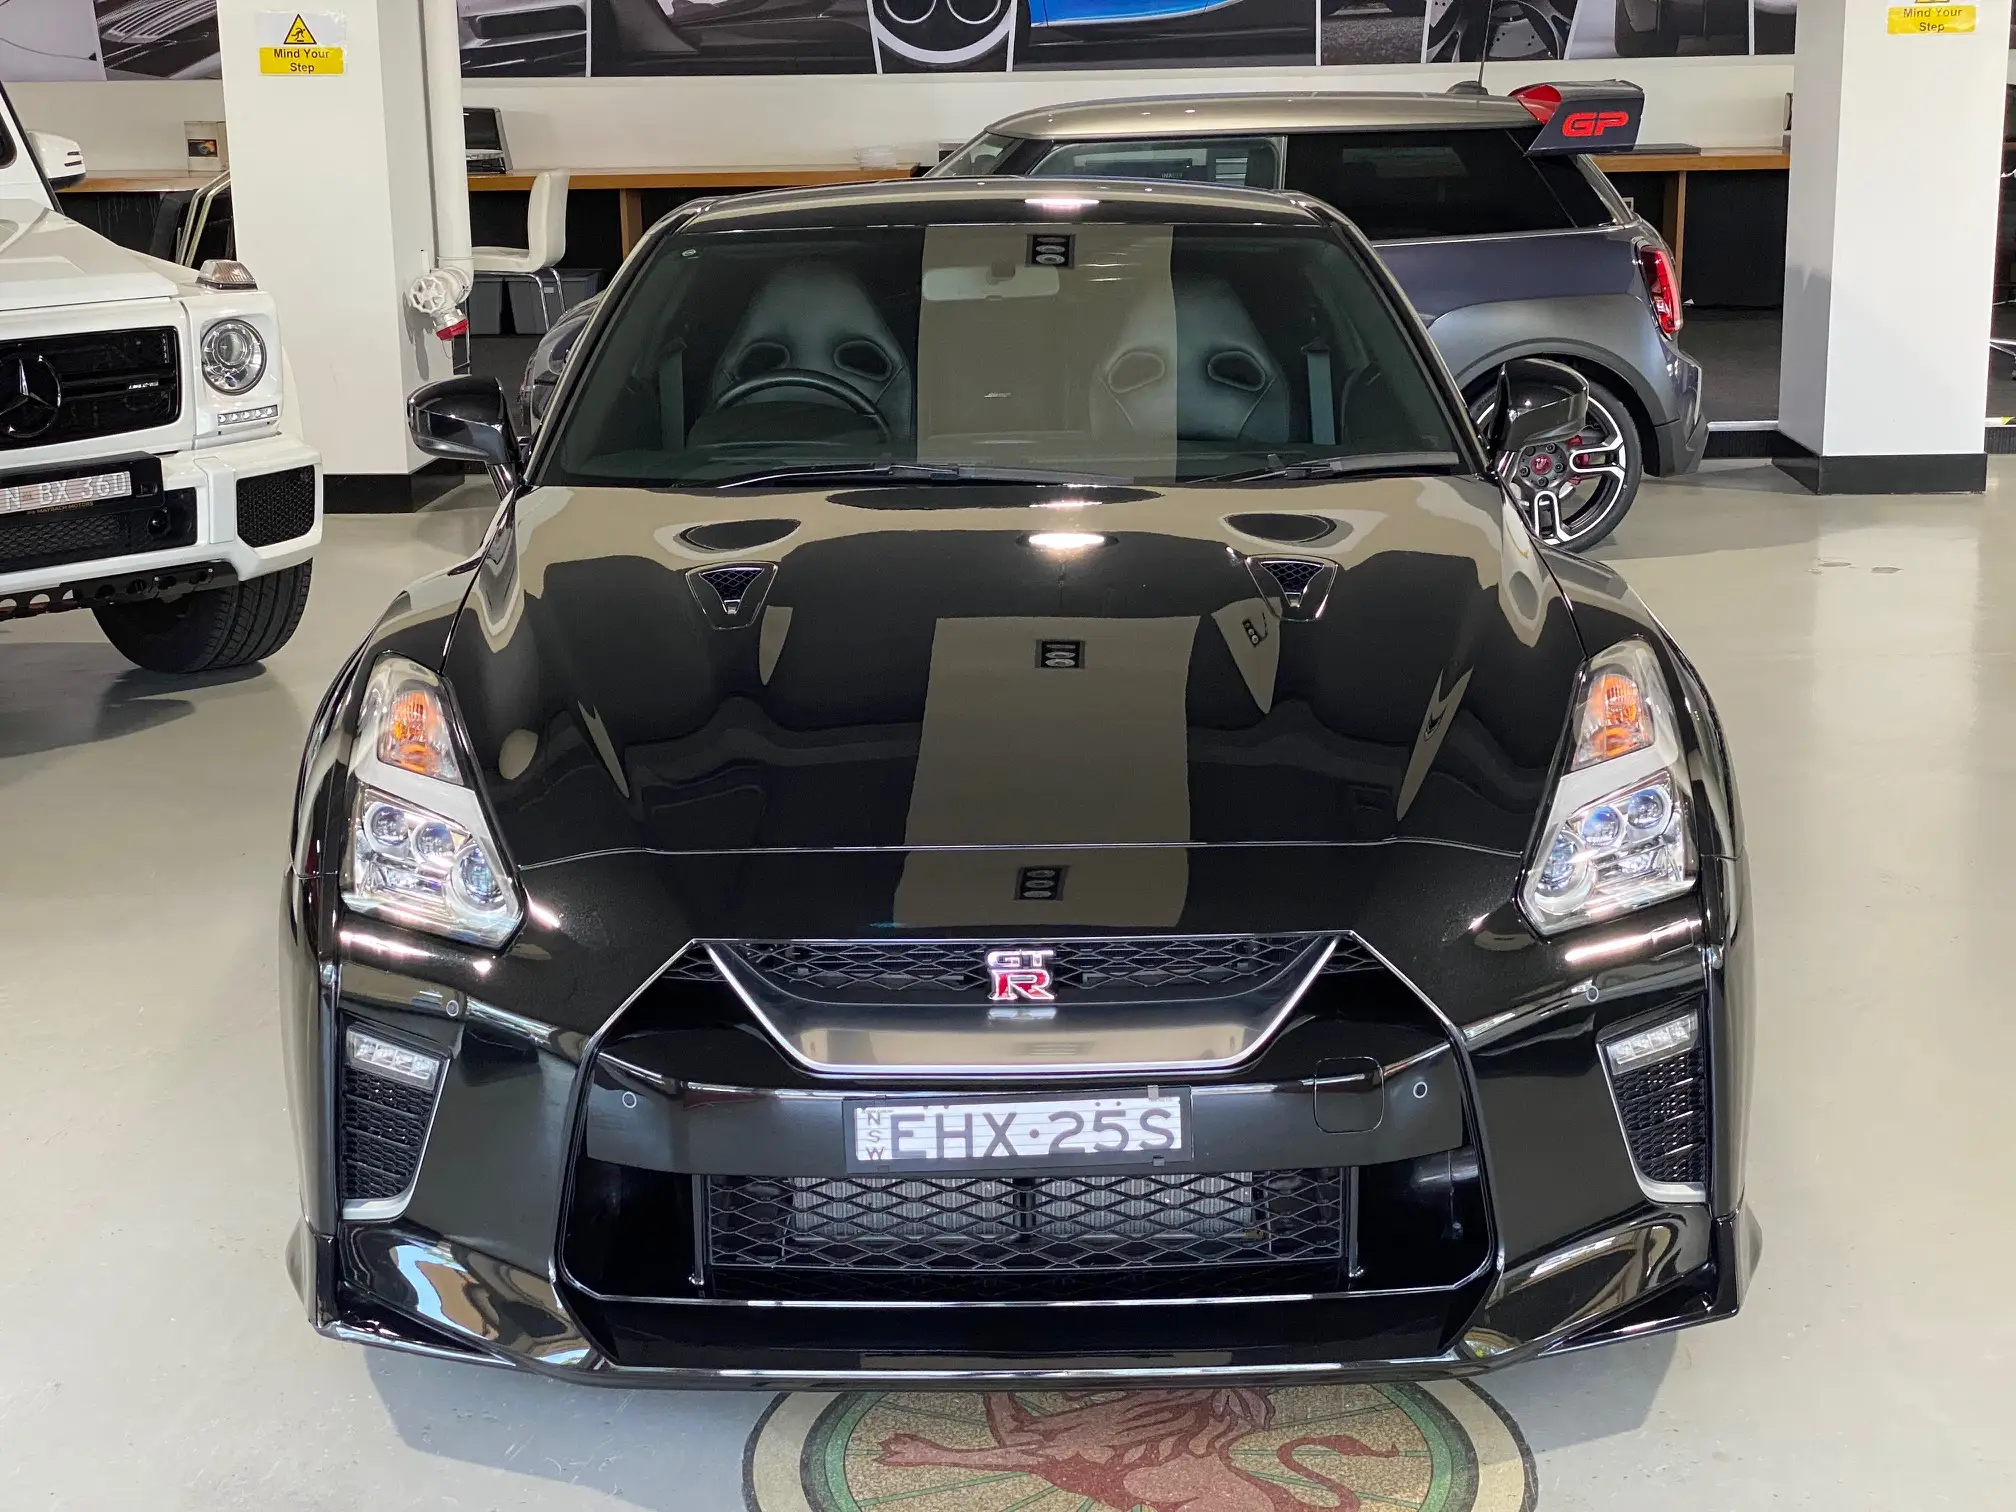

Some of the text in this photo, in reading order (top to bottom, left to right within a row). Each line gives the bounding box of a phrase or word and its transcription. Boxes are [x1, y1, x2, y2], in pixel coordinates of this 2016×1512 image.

[1903, 7, 1962, 18] Mind Your
[1919, 22, 1945, 33] Step
[273, 48, 330, 58] Mind Your
[290, 62, 315, 74] Step
[1562, 111, 1629, 137] GP
[987, 949, 1054, 967] GT
[987, 969, 1056, 1000] R
